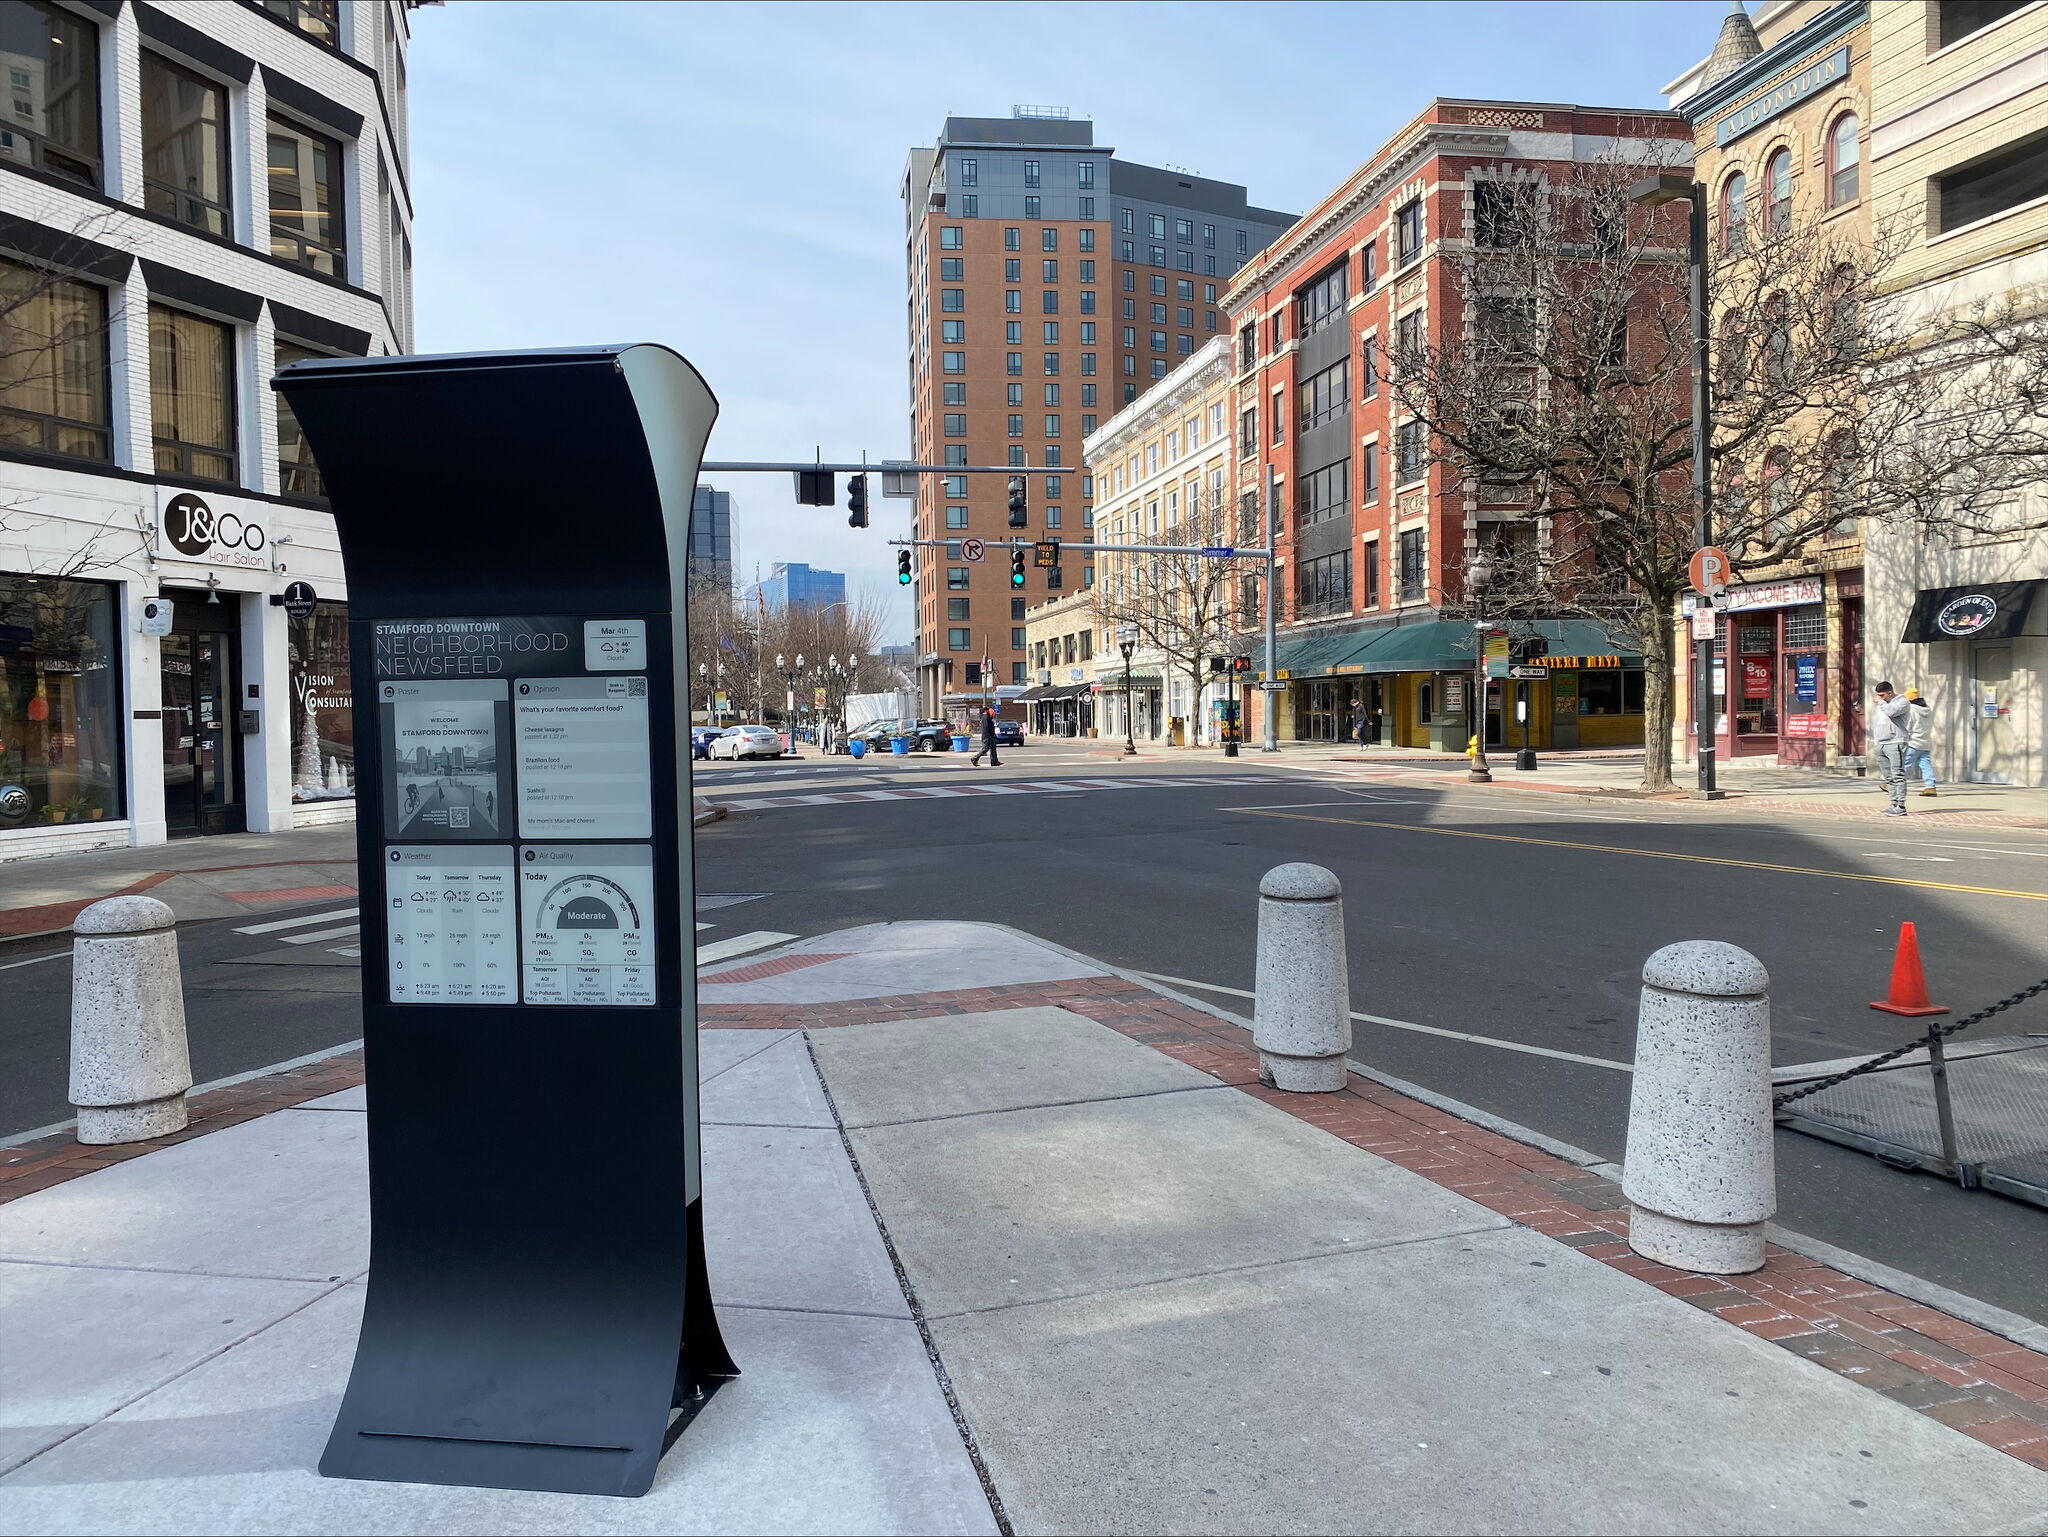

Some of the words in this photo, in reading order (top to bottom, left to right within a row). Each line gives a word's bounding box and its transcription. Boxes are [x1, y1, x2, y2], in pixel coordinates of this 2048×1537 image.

[1727, 58, 1837, 137] ALGONQUIN
[209, 550, 231, 563] Hair
[234, 553, 266, 567] Salon
[1203, 549, 1228, 557] Summer
[1702, 556, 1722, 587] P
[294, 584, 303, 600] 1
[1744, 584, 1790, 606] INCOME
[1793, 580, 1817, 600] TAX
[1943, 598, 1972, 618] GARDEN
[376, 623, 434, 635] STAMFORD
[436, 622, 500, 634] DOWNTOWN
[600, 627, 615, 635] Mar
[617, 626, 629, 635] 4th
[376, 632, 569, 655] NEIGHBORHOOD
[377, 655, 504, 677] NEWSFEED
[1529, 656, 1580, 668] RIVIERA
[1587, 655, 1621, 668] MAYA
[294, 675, 335, 703] VISION
[398, 687, 420, 695] Poster
[533, 686, 560, 695] Opinion
[606, 704, 624, 712] food?
[404, 852, 432, 860] Weather
[539, 852, 549, 860] Air
[550, 852, 574, 861] Quality
[525, 872, 548, 882] Today
[567, 910, 607, 920] Moderate
[626, 949, 637, 957] CO
